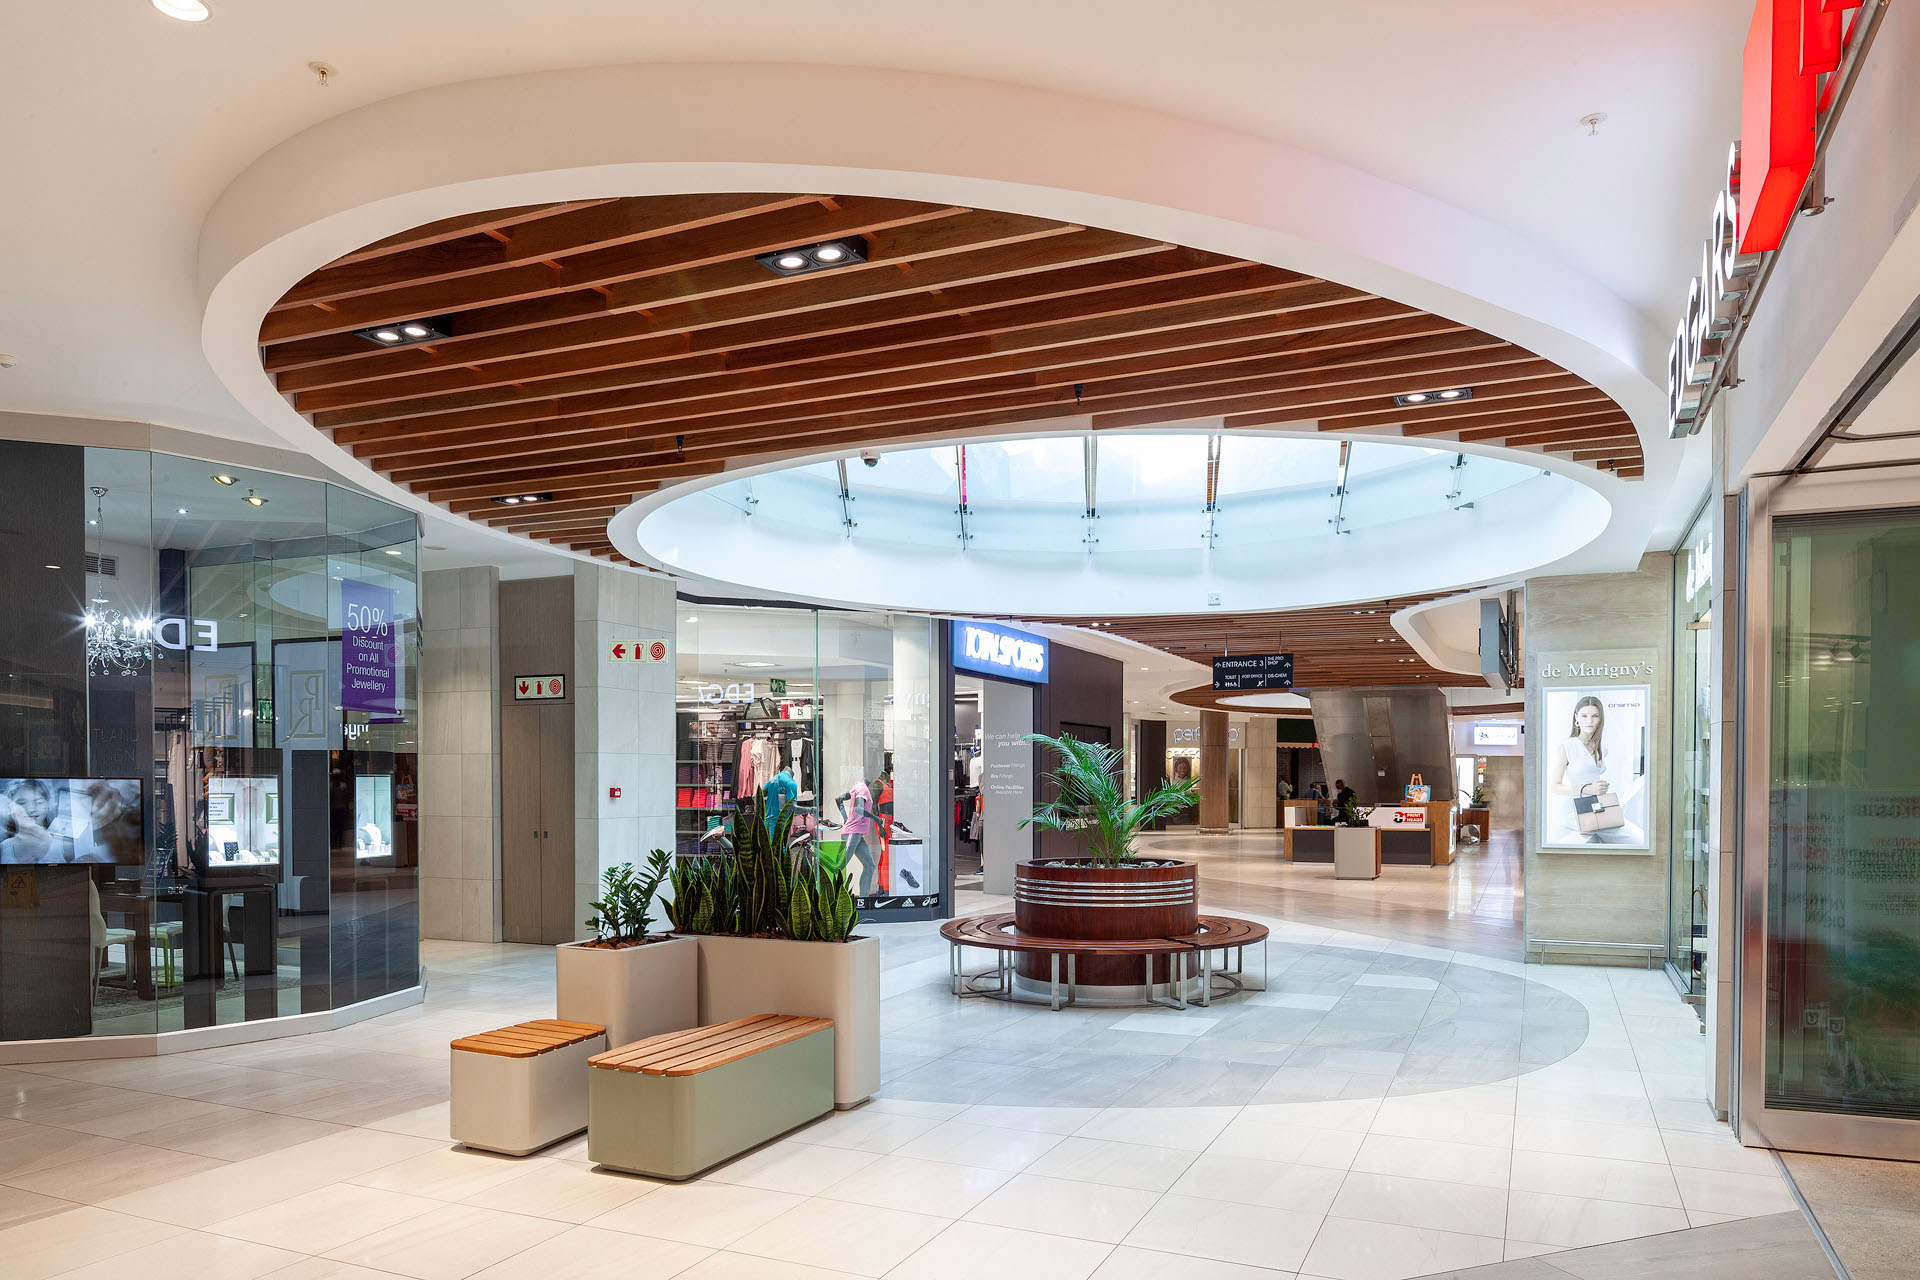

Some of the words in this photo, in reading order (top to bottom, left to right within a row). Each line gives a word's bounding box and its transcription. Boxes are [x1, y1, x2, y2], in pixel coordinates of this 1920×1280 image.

[1669, 140, 1738, 440] EDGARS
[347, 603, 388, 636] 50%
[352, 636, 384, 650] Discount
[358, 652, 369, 661] on
[369, 653, 379, 663] All
[1221, 660, 1257, 668] ENTRANCE
[346, 663, 390, 678] Promotional
[1541, 663, 1561, 678] de
[1568, 661, 1654, 679] Marigny's
[351, 678, 386, 693] Jewellery
